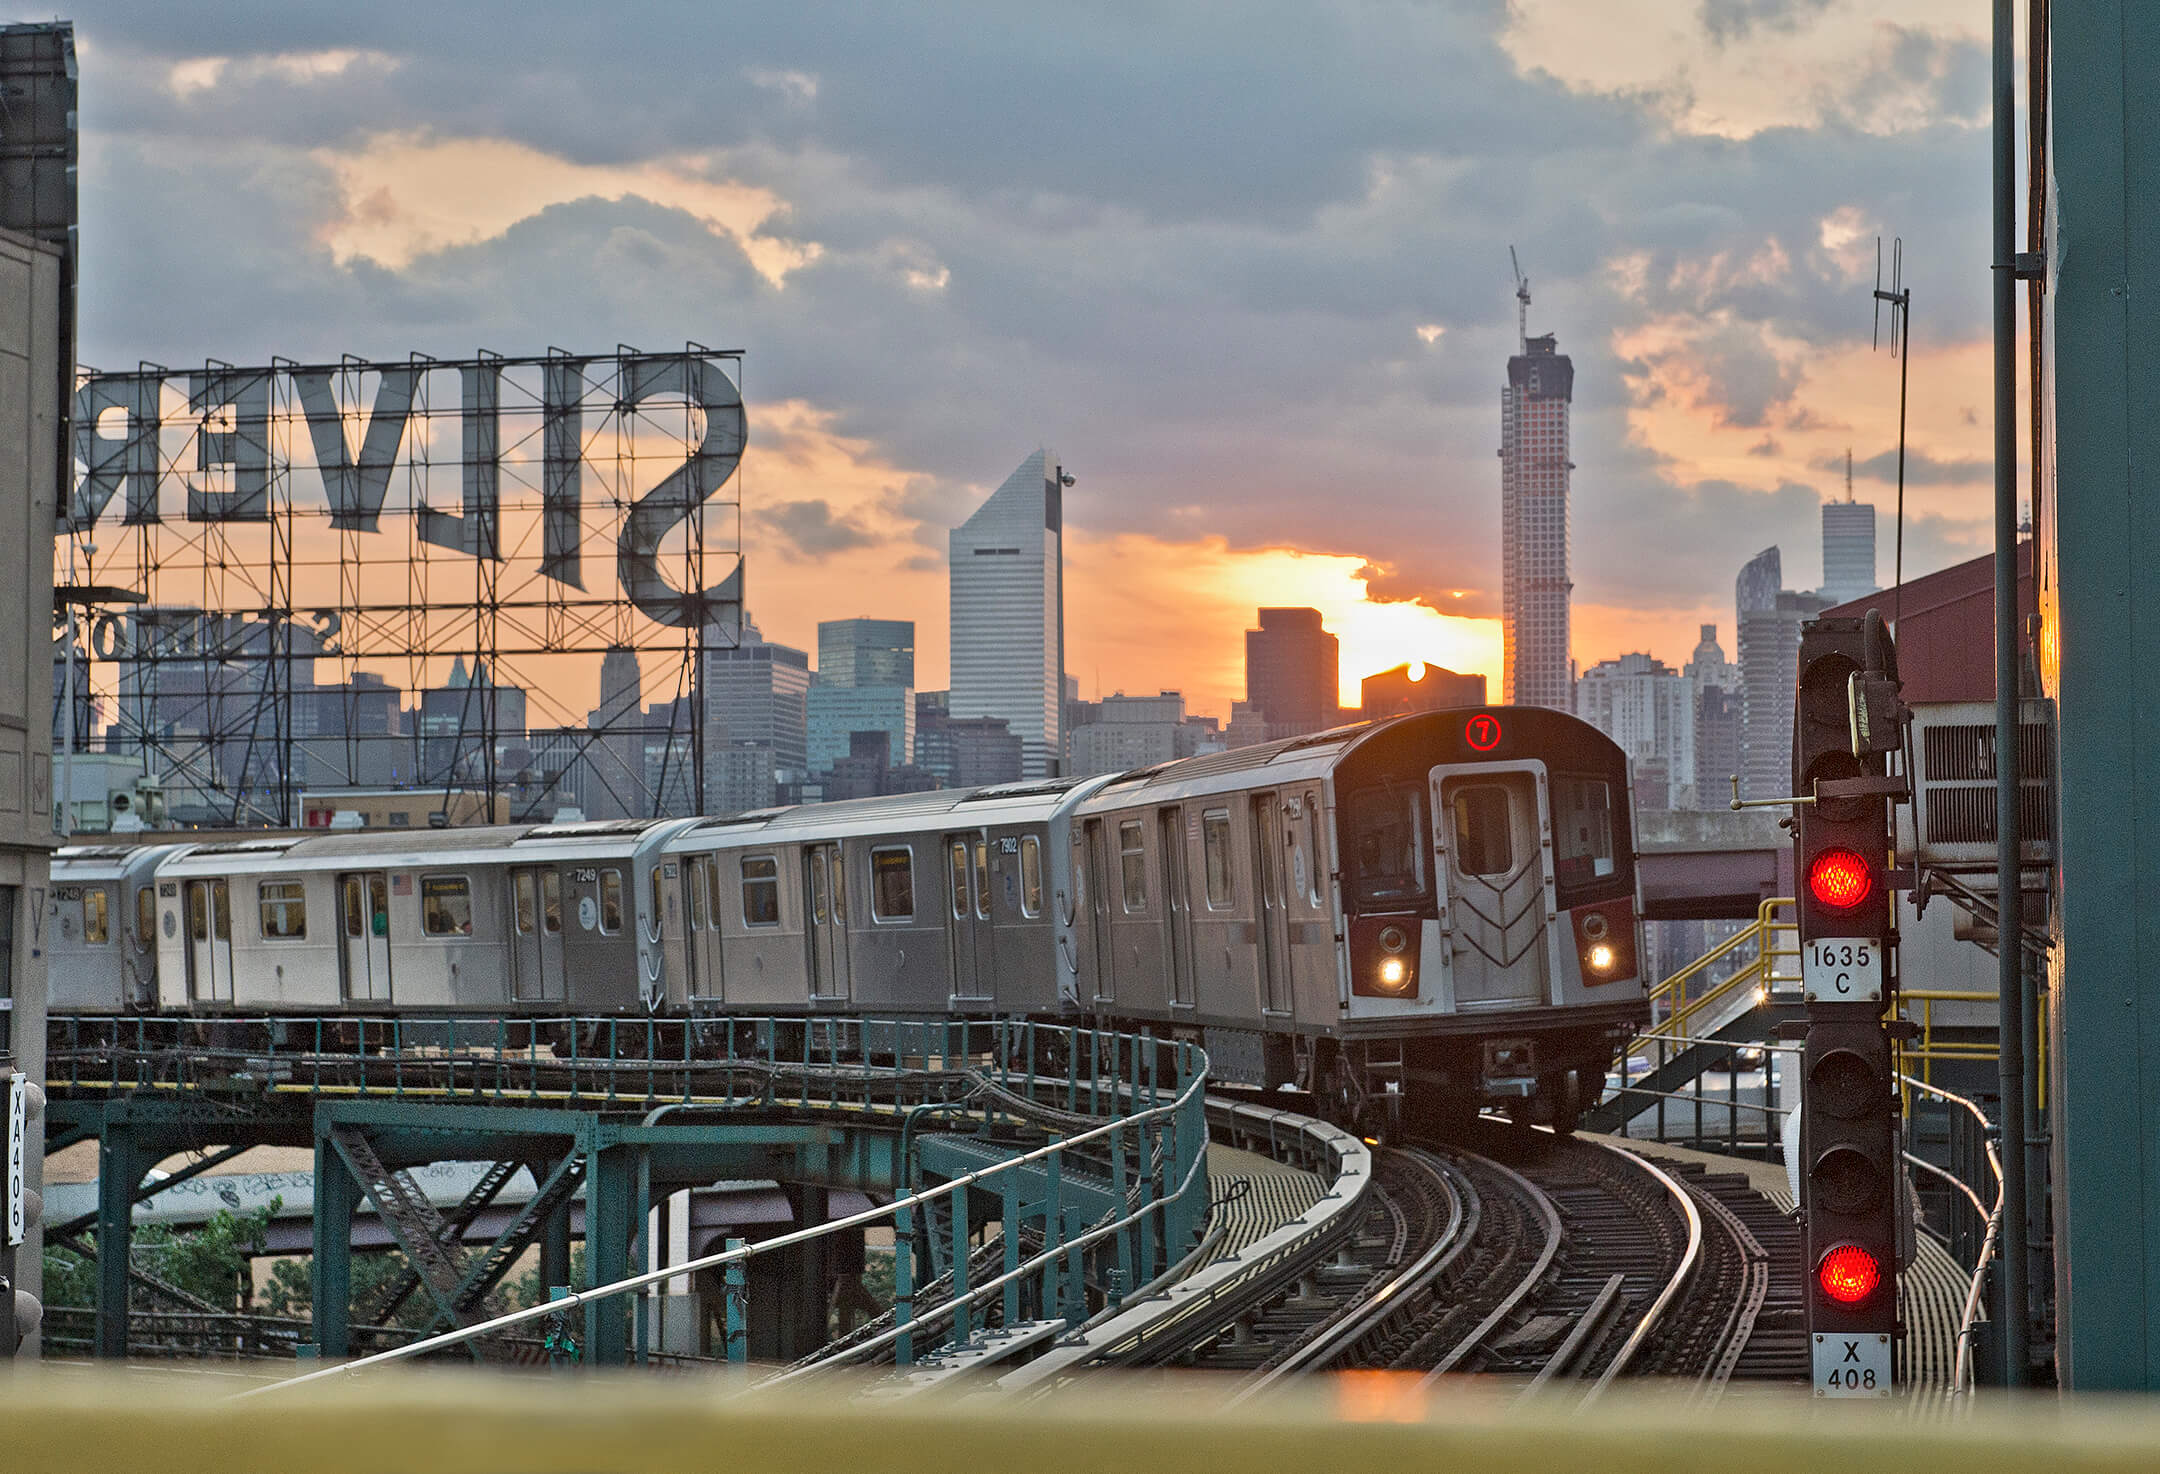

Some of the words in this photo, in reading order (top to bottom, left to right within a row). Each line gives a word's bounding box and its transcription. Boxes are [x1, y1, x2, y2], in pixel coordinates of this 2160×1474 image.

[1476, 720, 1490, 743] 7
[576, 868, 597, 882] 7249
[1814, 945, 1870, 967] 1635
[1836, 972, 1850, 993] C
[13, 1090, 21, 1227] XA406
[1843, 1341, 1860, 1362] X
[1828, 1368, 1876, 1390] 408
